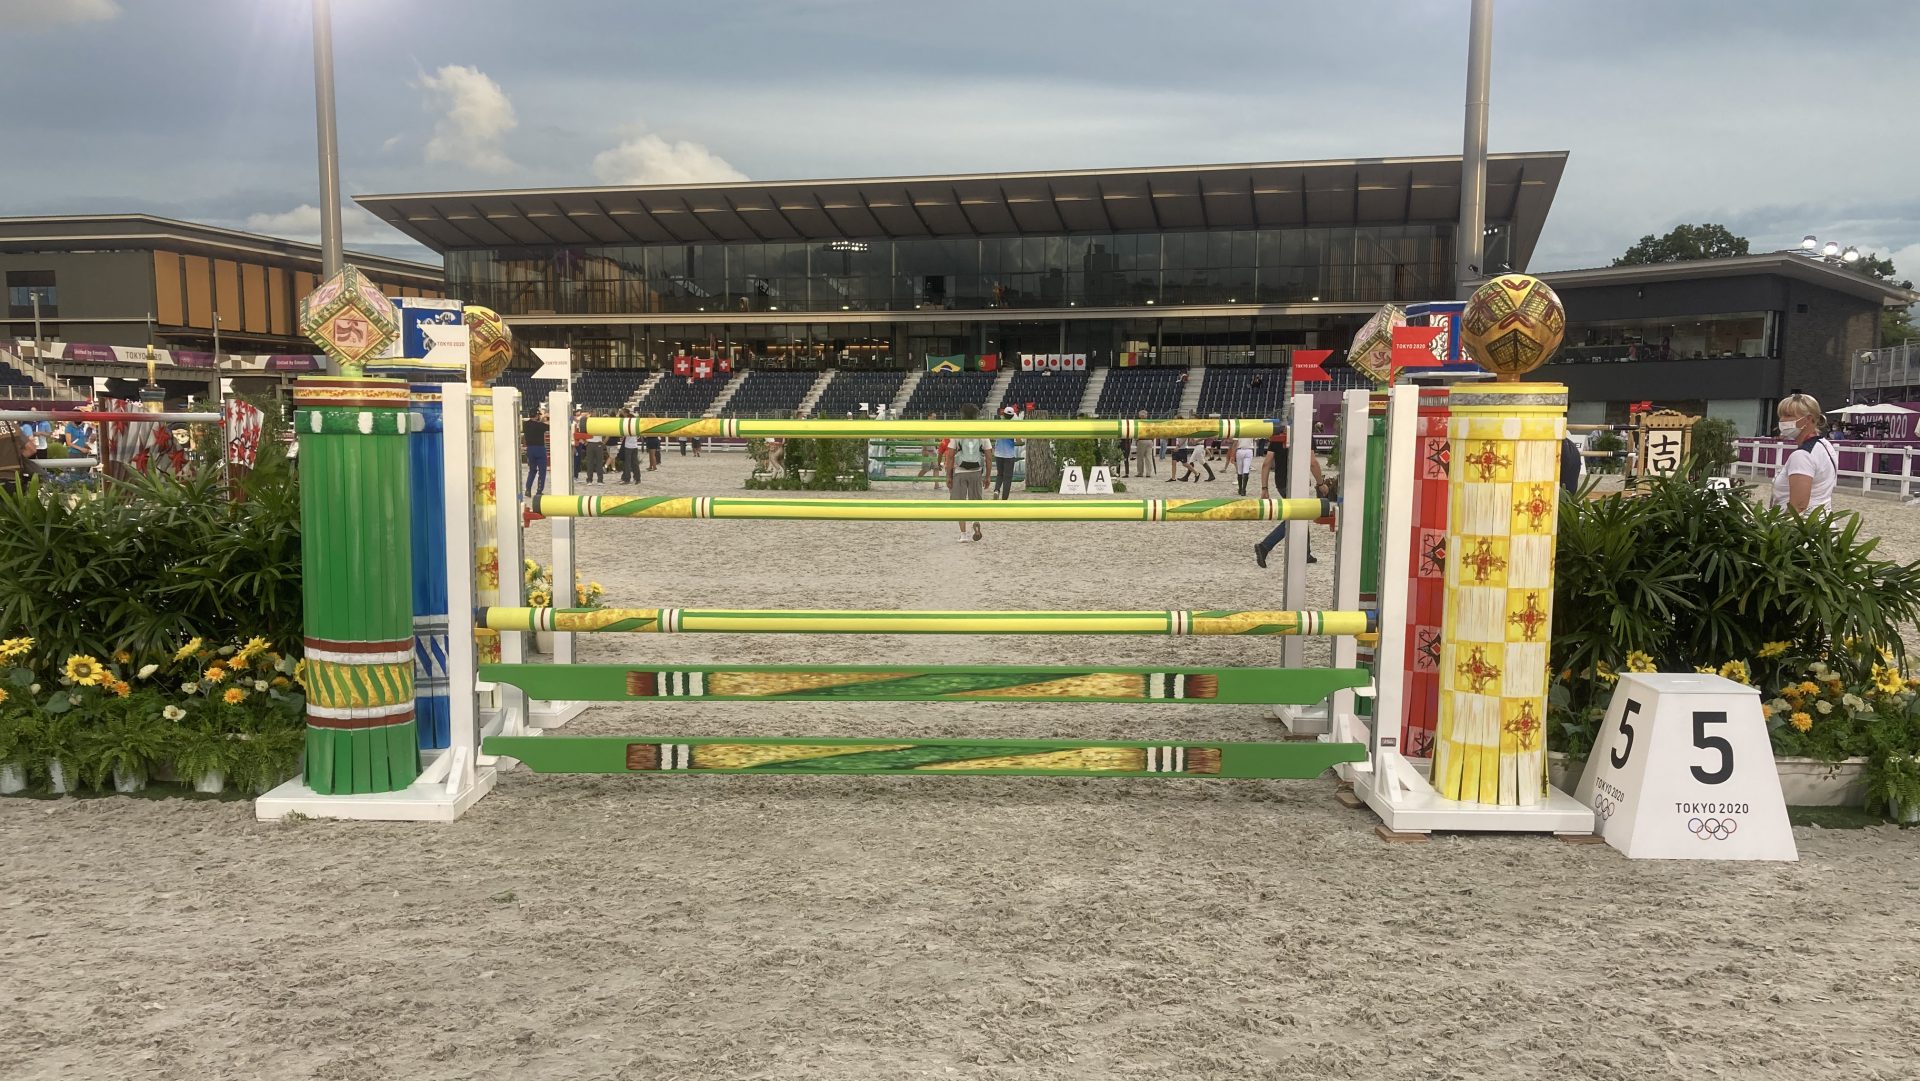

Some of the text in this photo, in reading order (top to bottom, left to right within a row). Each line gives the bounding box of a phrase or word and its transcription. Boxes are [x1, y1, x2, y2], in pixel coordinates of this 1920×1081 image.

[125, 351, 146, 360] TOKYO
[1651, 435, 1679, 472] 吉
[1069, 470, 1077, 482] 6
[1095, 470, 1105, 482] A
[1610, 698, 1642, 769] 5
[1690, 711, 1734, 784] 5
[1595, 776, 1625, 803] TOKYO 2020
[1675, 802, 1749, 814] TOKYO 2020
